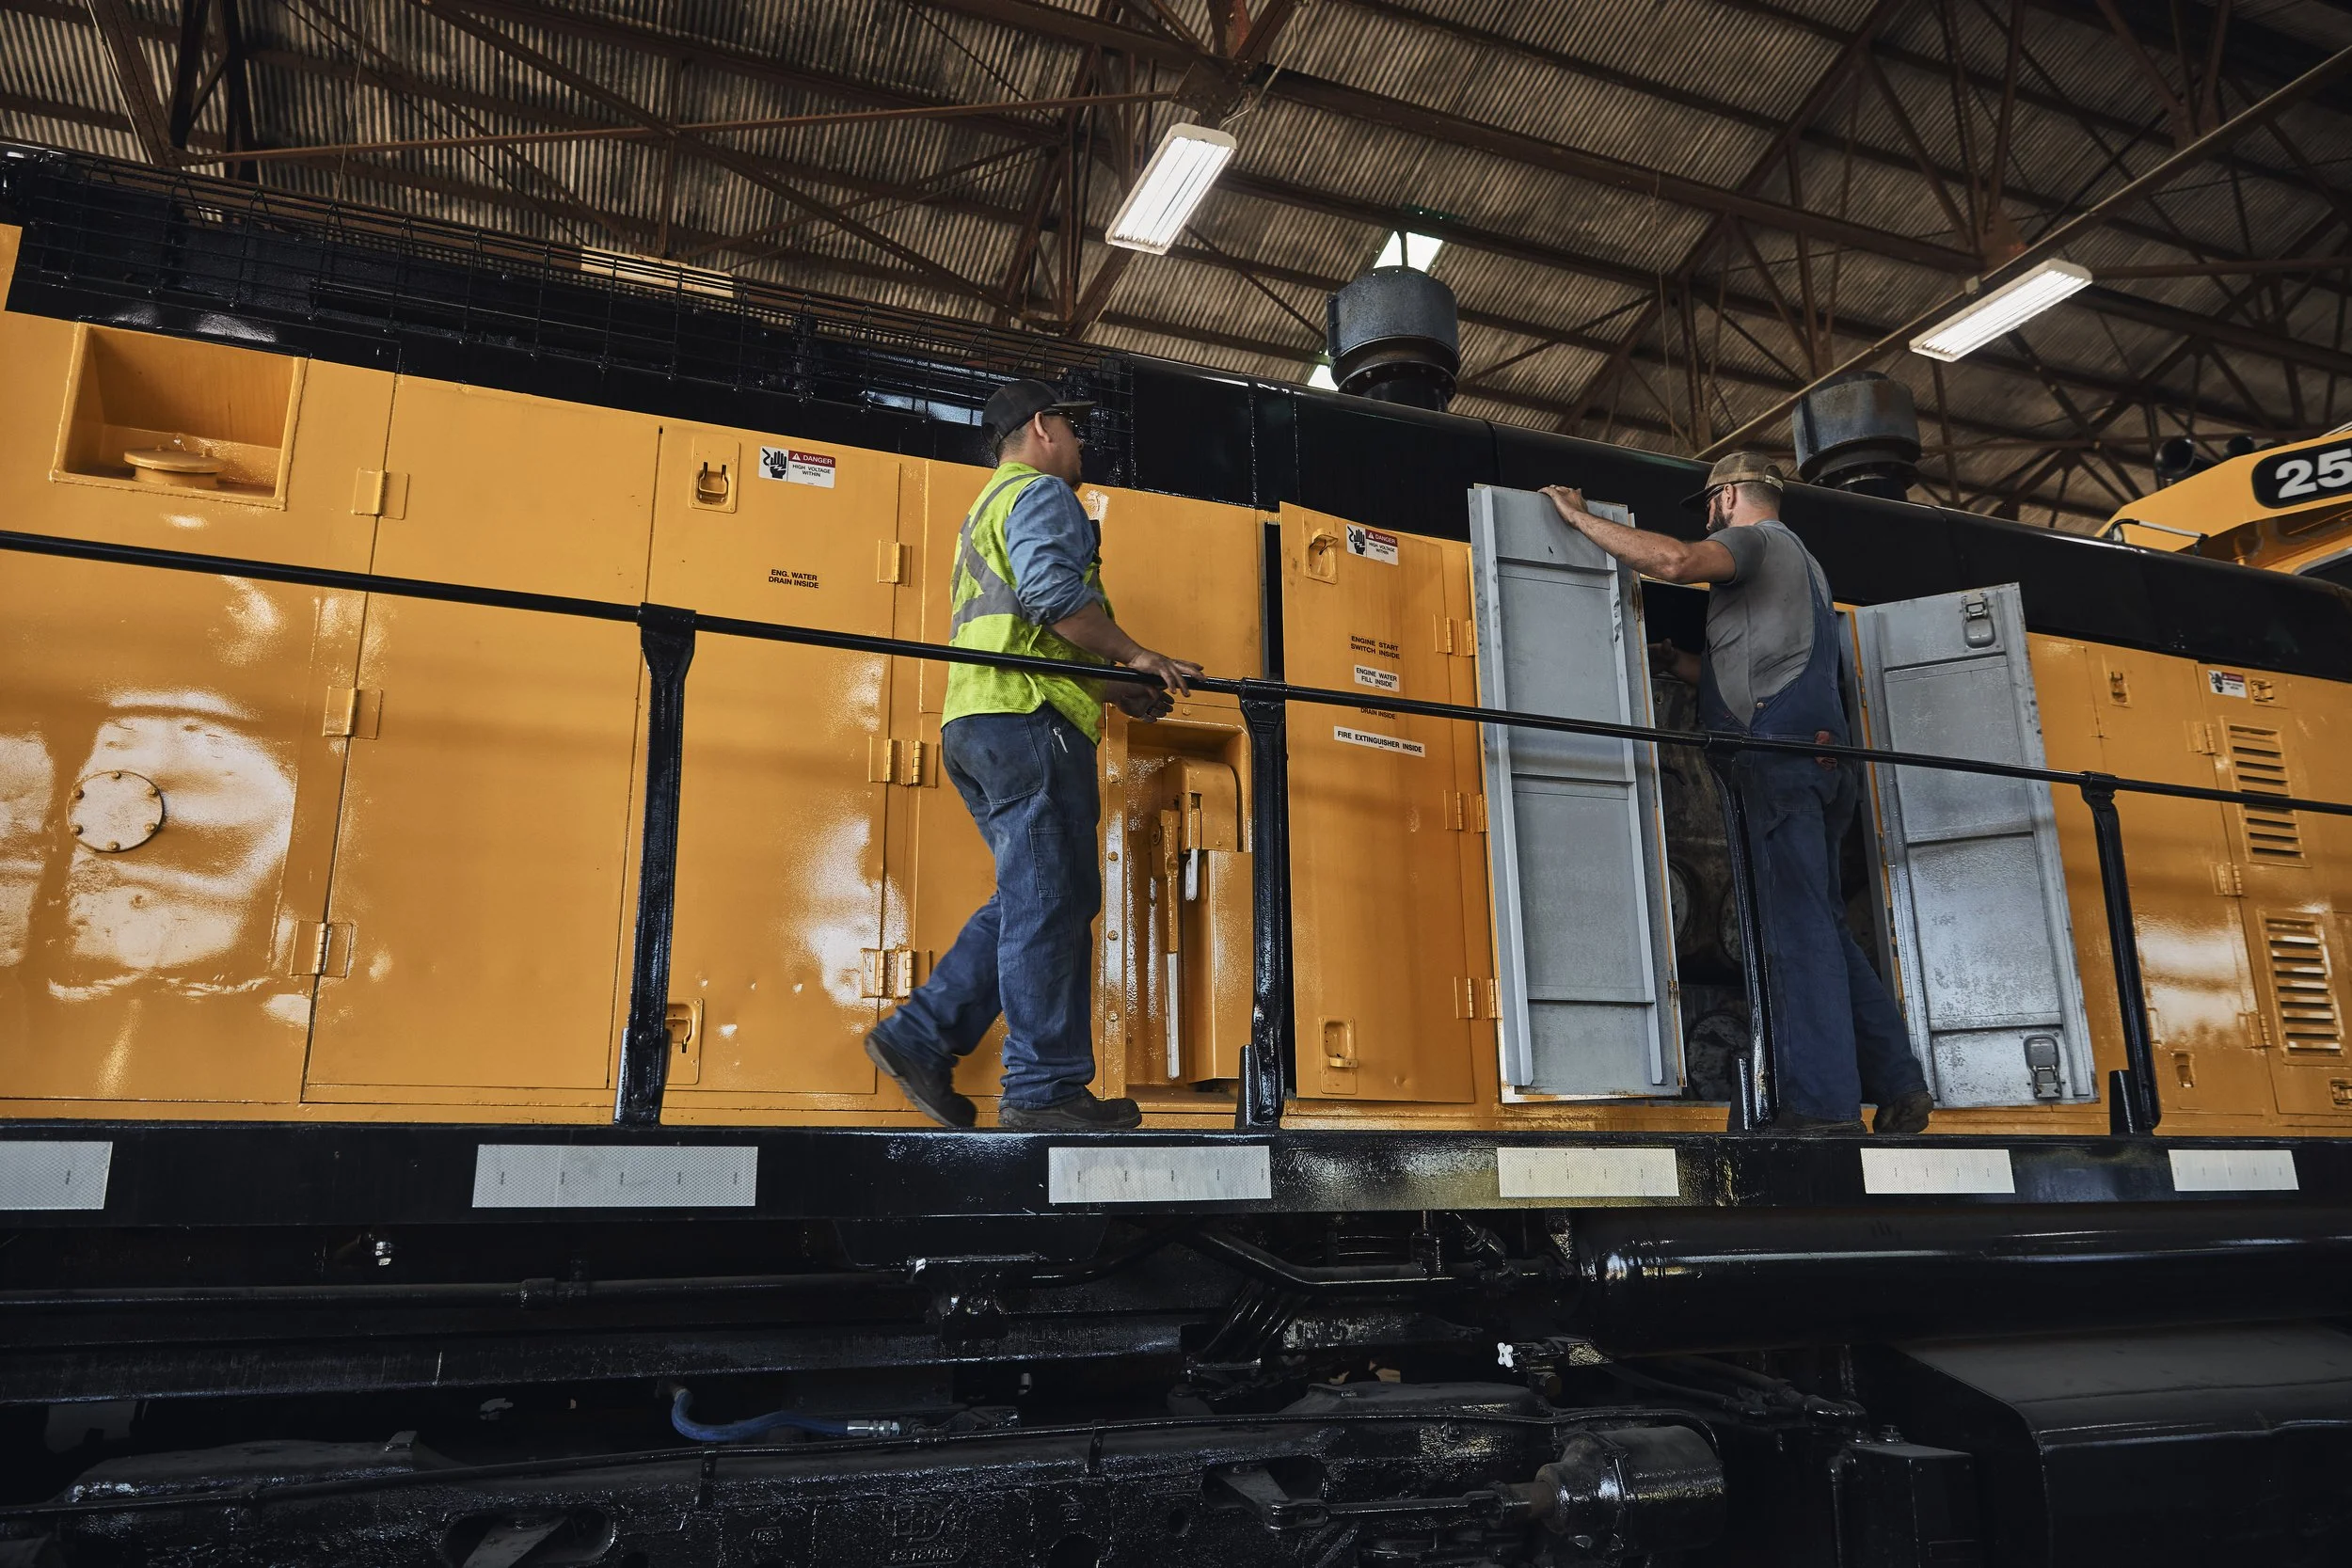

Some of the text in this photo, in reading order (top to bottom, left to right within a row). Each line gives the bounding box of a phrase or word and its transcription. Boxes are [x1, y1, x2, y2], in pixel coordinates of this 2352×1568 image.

[803, 454, 833, 465] DANGER
[808, 466, 831, 474] VOLTAGE
[1375, 534, 1396, 544] DANGER
[771, 568, 818, 581] ENG. WATER
[768, 576, 819, 589] DRAIN INSIDE
[1351, 636, 1399, 651] ENGINE START
[1350, 643, 1400, 659] SWITCH INSIDE
[1356, 667, 1398, 682] ENGINE WATER
[1375, 678, 1392, 688] INSIDE
[1360, 707, 1396, 720] DRAIN INSIDE
[1337, 730, 1422, 753] FIRE EXTINGUISHER INSIDE
